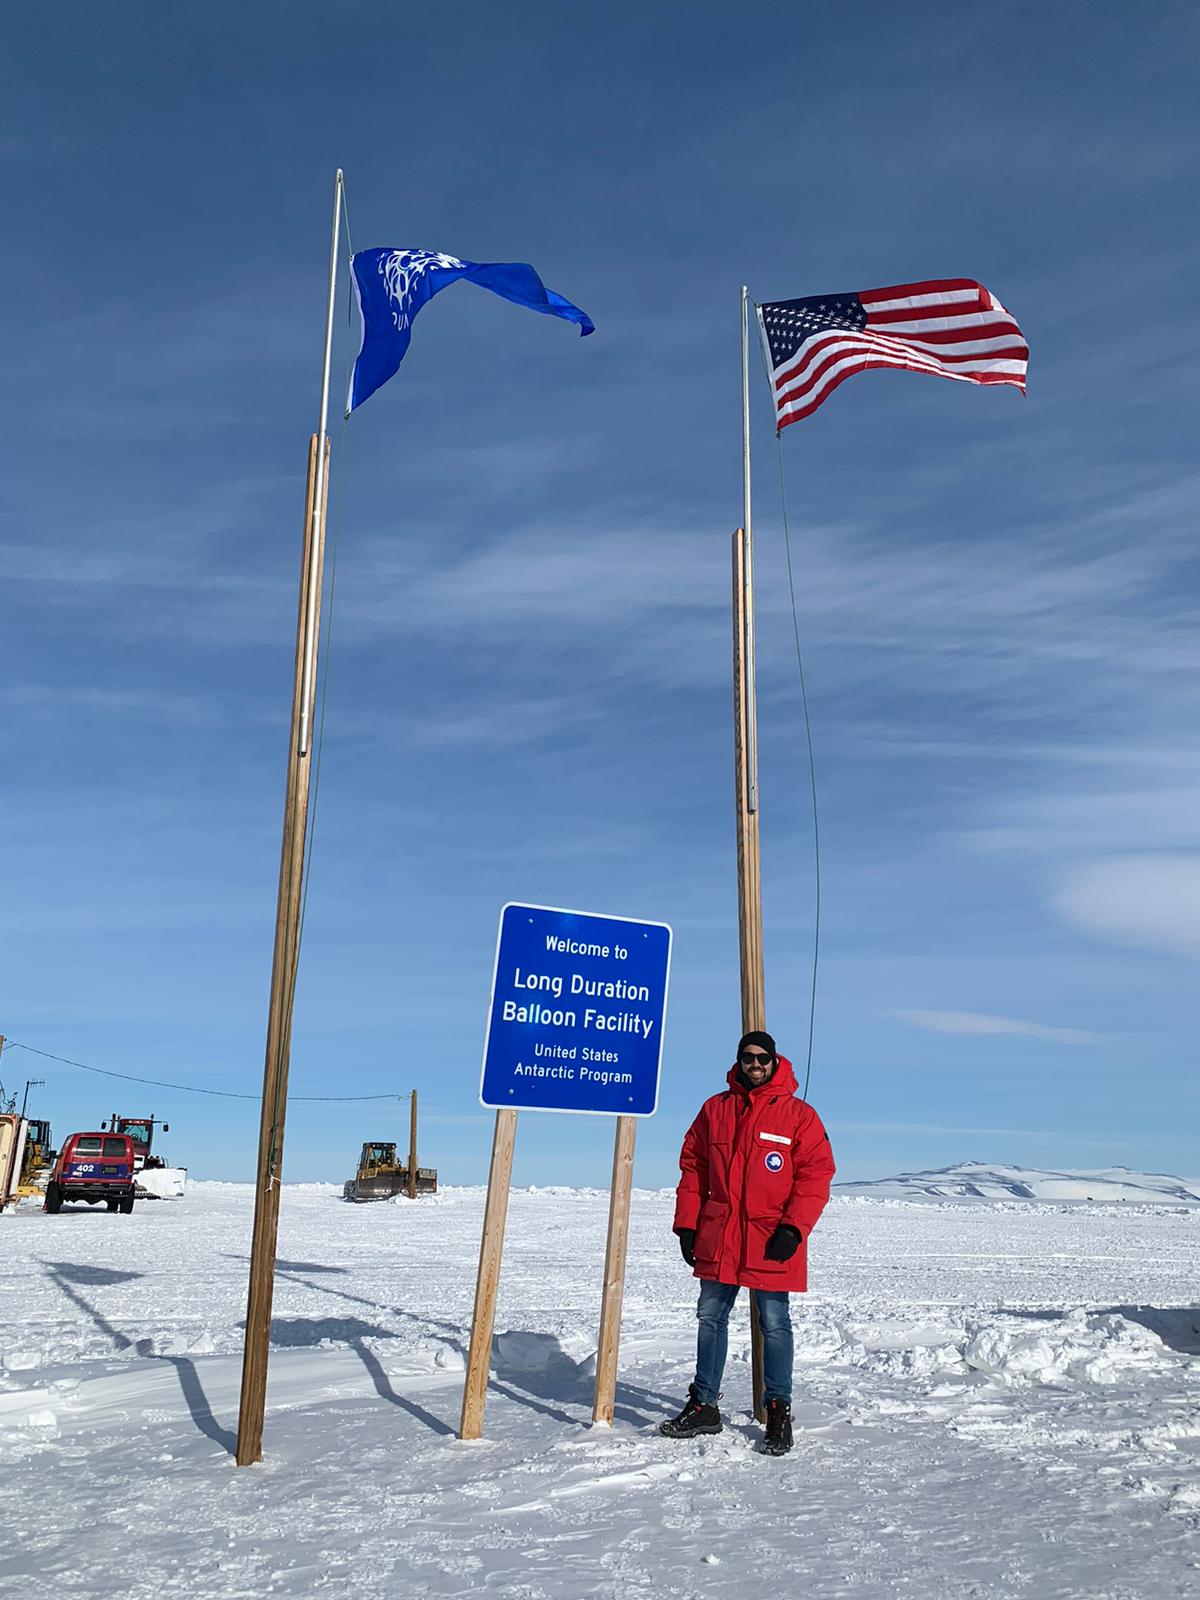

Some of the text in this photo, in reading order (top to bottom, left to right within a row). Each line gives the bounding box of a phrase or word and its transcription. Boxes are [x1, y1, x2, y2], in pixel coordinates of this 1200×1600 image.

[546, 935, 628, 960] Welcome to
[514, 968, 649, 1001] Long Duration
[503, 1001, 653, 1039] Balloon Facility
[534, 1043, 619, 1063] United States
[514, 1063, 632, 1085] Antarctic Program
[77, 1164, 94, 1172] 402
